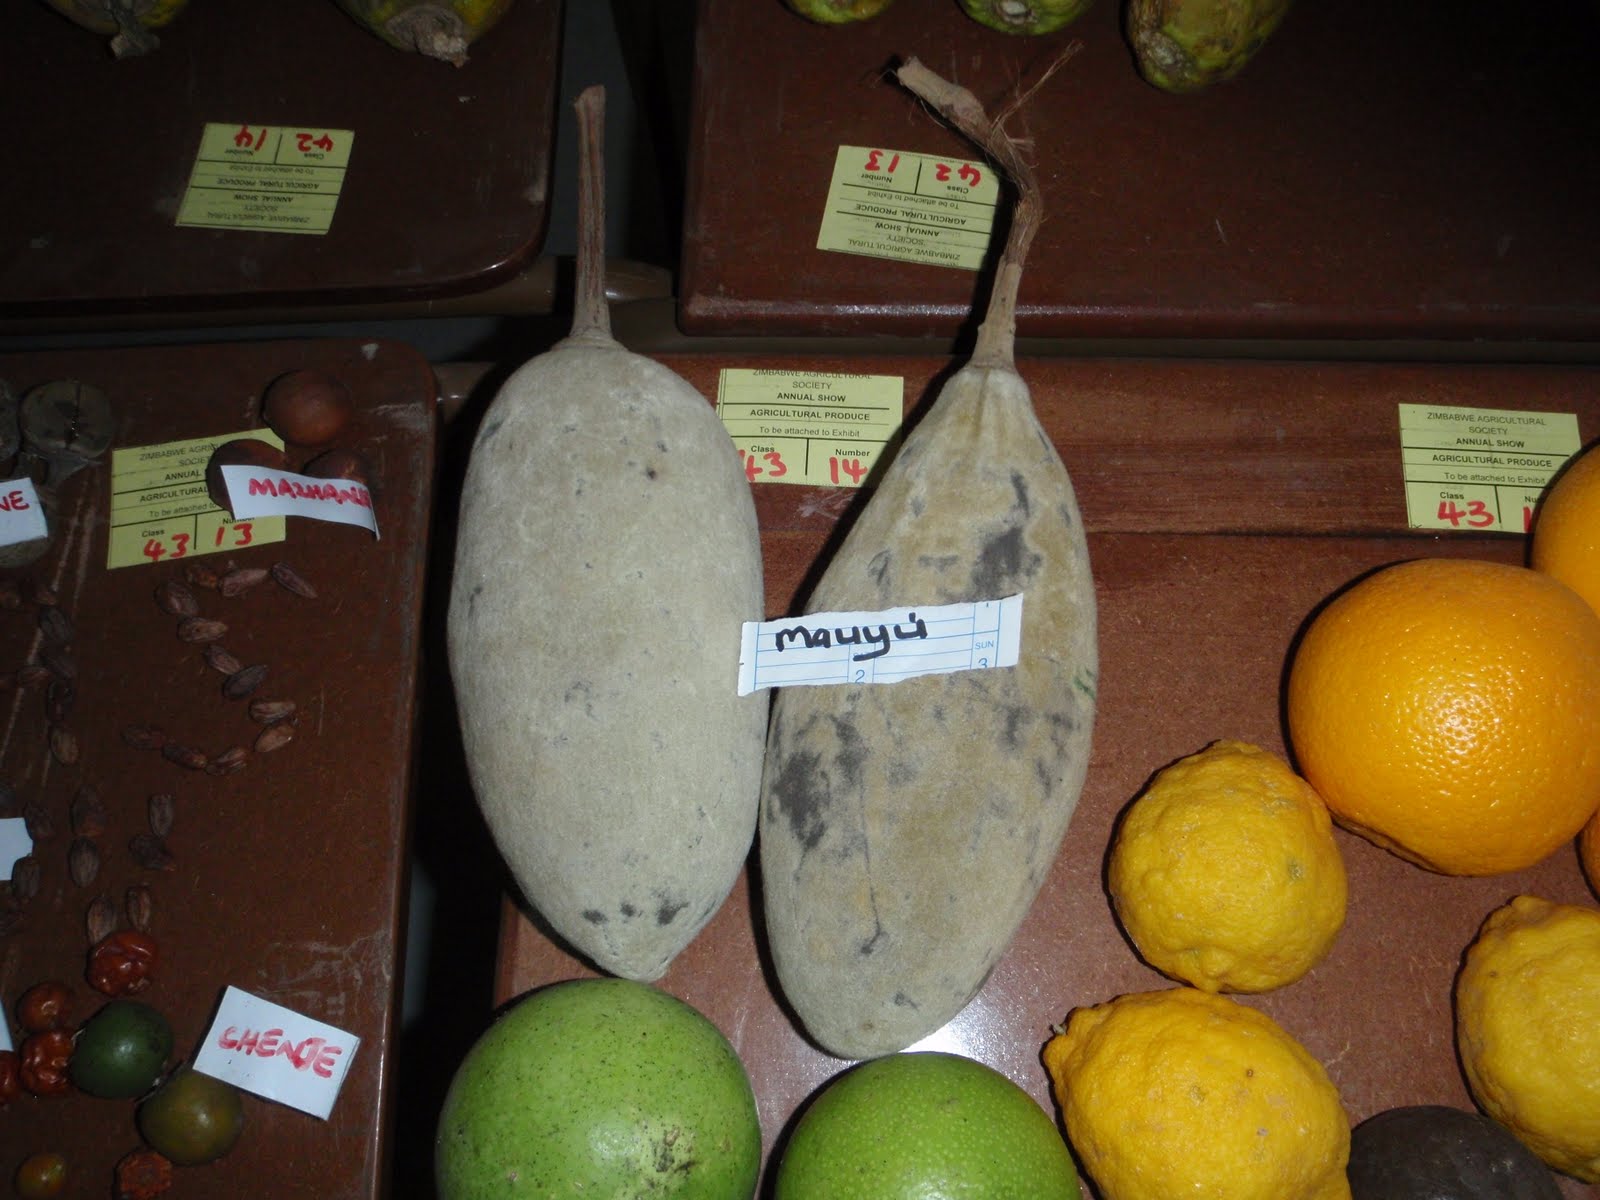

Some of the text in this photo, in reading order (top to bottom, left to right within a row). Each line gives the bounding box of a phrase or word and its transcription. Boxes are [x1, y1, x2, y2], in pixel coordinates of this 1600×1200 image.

[233, 124, 268, 152] 14
[295, 132, 335, 153] 42
[864, 149, 901, 174] 13
[935, 163, 982, 188] 42
[216, 177, 320, 190] AGRICULTURAL PRODUCE
[860, 173, 970, 195] Class Number
[233, 193, 294, 204] ANNUAL SHOW
[867, 190, 960, 211] To be attached to Exhibit
[855, 203, 967, 226] AGRICULTURAL PRODUCE
[874, 222, 940, 237] ANNUAL SHOW
[886, 233, 925, 246] SOCIETY
[847, 238, 961, 261] ZIMBABWE AGRICULTURAL
[752, 368, 801, 379] ZIMBABWE
[792, 380, 833, 390] SOCIETY
[776, 391, 847, 403] ANNUAL SHOW
[749, 408, 871, 422] AGRICULTURAL PRODUCE
[1426, 411, 1548, 427] ZIMBABWE AGRICULTURAL
[759, 425, 861, 438] To be attached to Exhibit
[1468, 426, 1509, 436] SOCIETY
[1455, 437, 1526, 449] ANNUAL SHOW
[750, 444, 871, 458] Class Number
[177, 456, 212, 467] SOCIET
[738, 449, 788, 482] 43
[1432, 453, 1554, 468] AGRICULTURAL PRODUCE
[163, 470, 203, 482] ANNUAL
[828, 456, 869, 485] 14
[1443, 472, 1546, 485] To be attached to Exhibit
[139, 485, 209, 504] AGRICULTURAL
[1439, 491, 1465, 501] Class
[149, 510, 160, 519] To
[161, 507, 172, 517] be
[173, 504, 208, 515] attached
[1436, 500, 1496, 528] 43
[141, 528, 166, 539] Class
[215, 522, 254, 548] 13
[143, 533, 191, 562] 43
[974, 640, 995, 651] SUN
